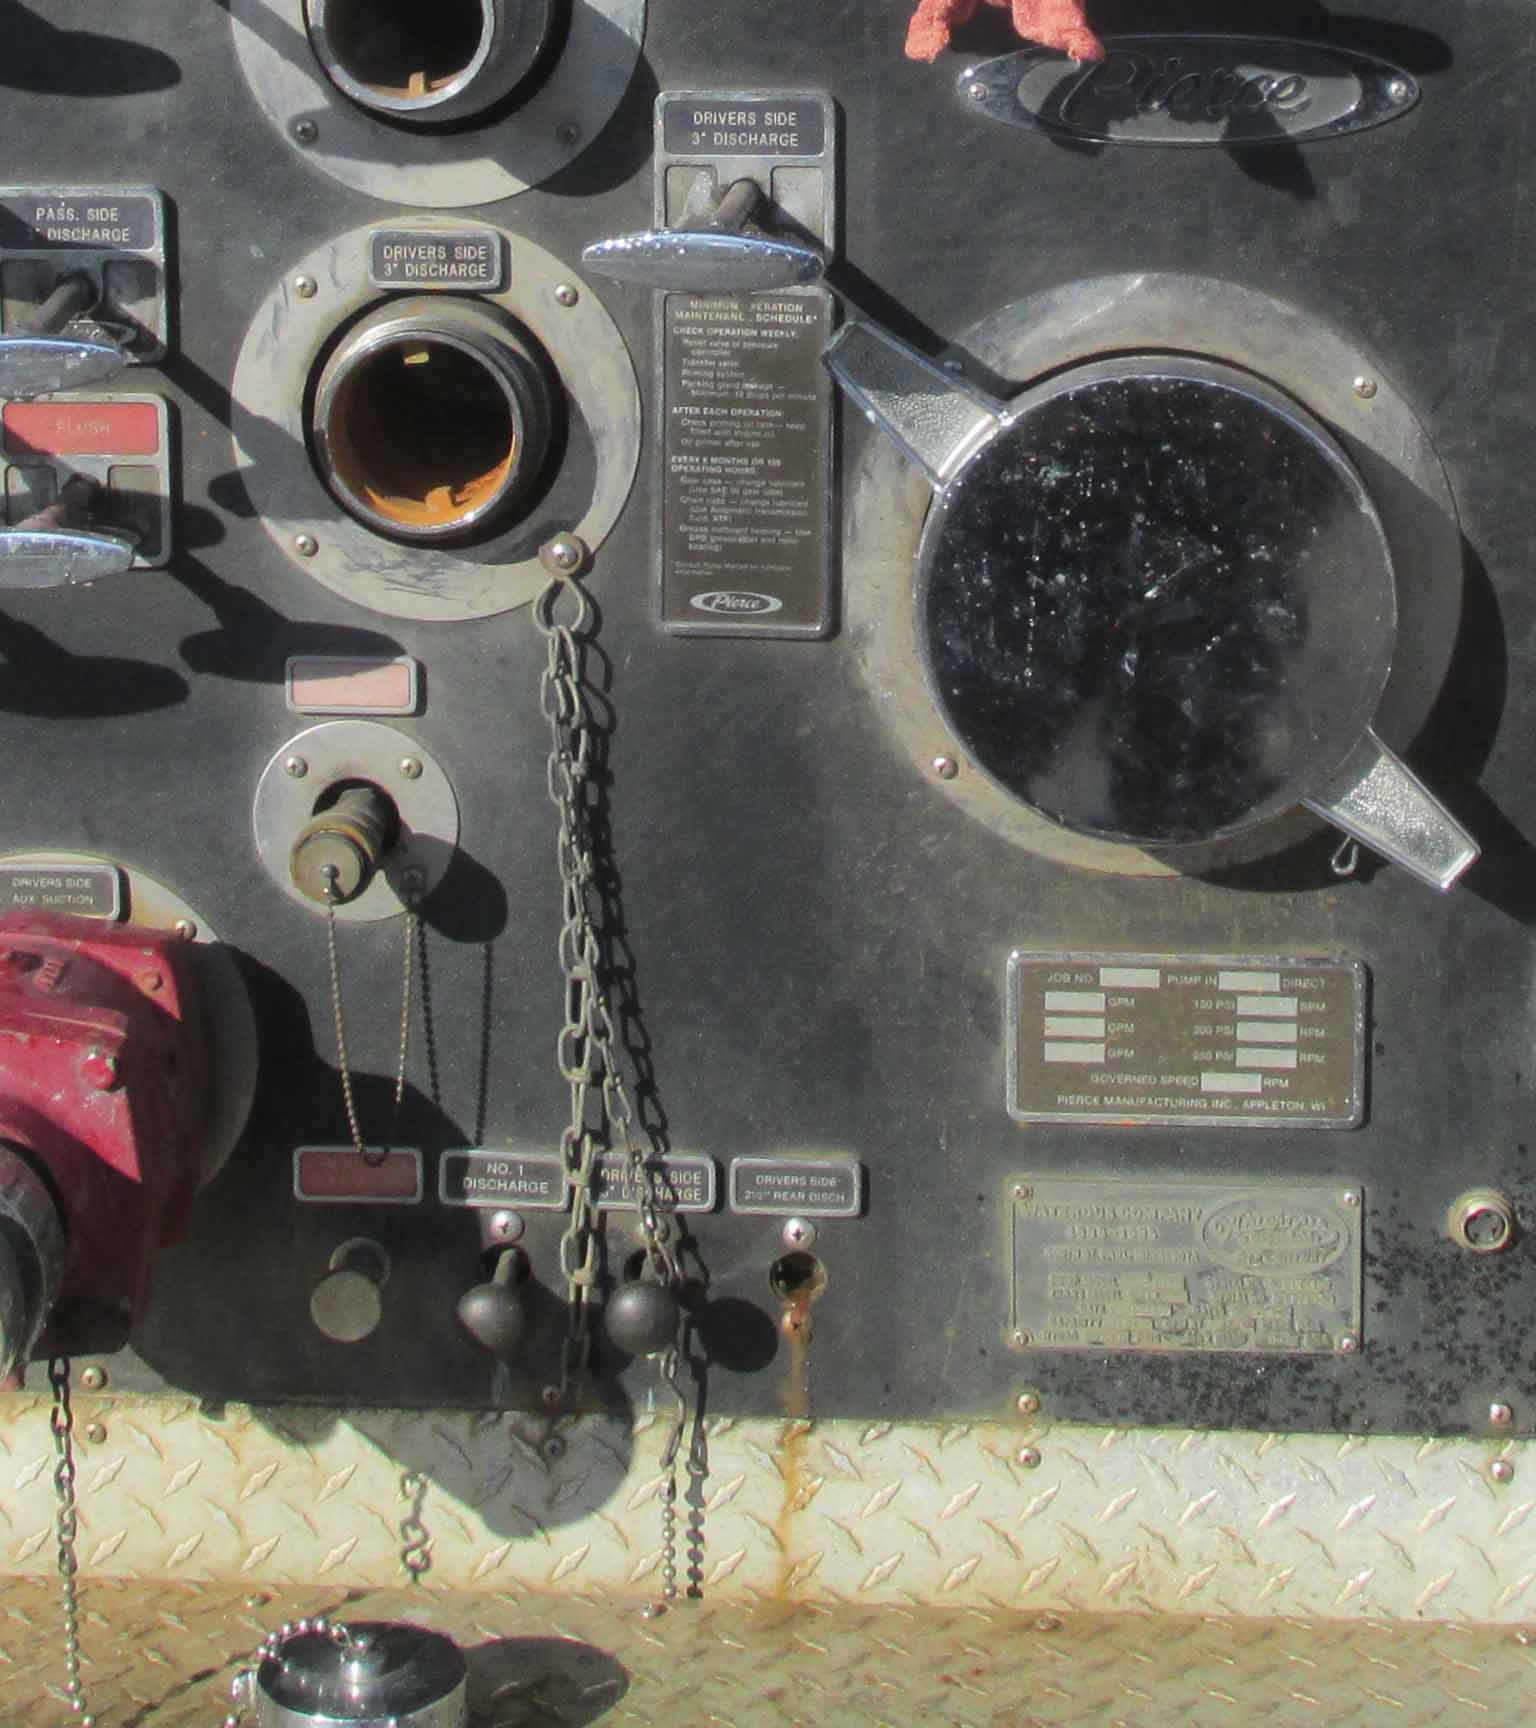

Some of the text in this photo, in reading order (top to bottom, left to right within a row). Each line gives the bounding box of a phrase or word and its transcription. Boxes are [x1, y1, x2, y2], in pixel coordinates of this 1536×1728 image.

[693, 111, 797, 127] DRIVERS SIDE
[712, 132, 799, 148] DISCHARGE
[36, 206, 119, 222] PASS. SIDE
[383, 245, 487, 261] DRIVERS SIDE
[404, 263, 488, 278] DISCHARGE
[673, 327, 704, 335] CHECK
[707, 328, 758, 336] OPERATION
[1091, 1075, 1198, 1086] GOVERNED SPEED
[1057, 1095, 1100, 1106] PIERCE
[1104, 1096, 1207, 1108] MANUFACTURING
[464, 1178, 548, 1194] DISCHARGE
